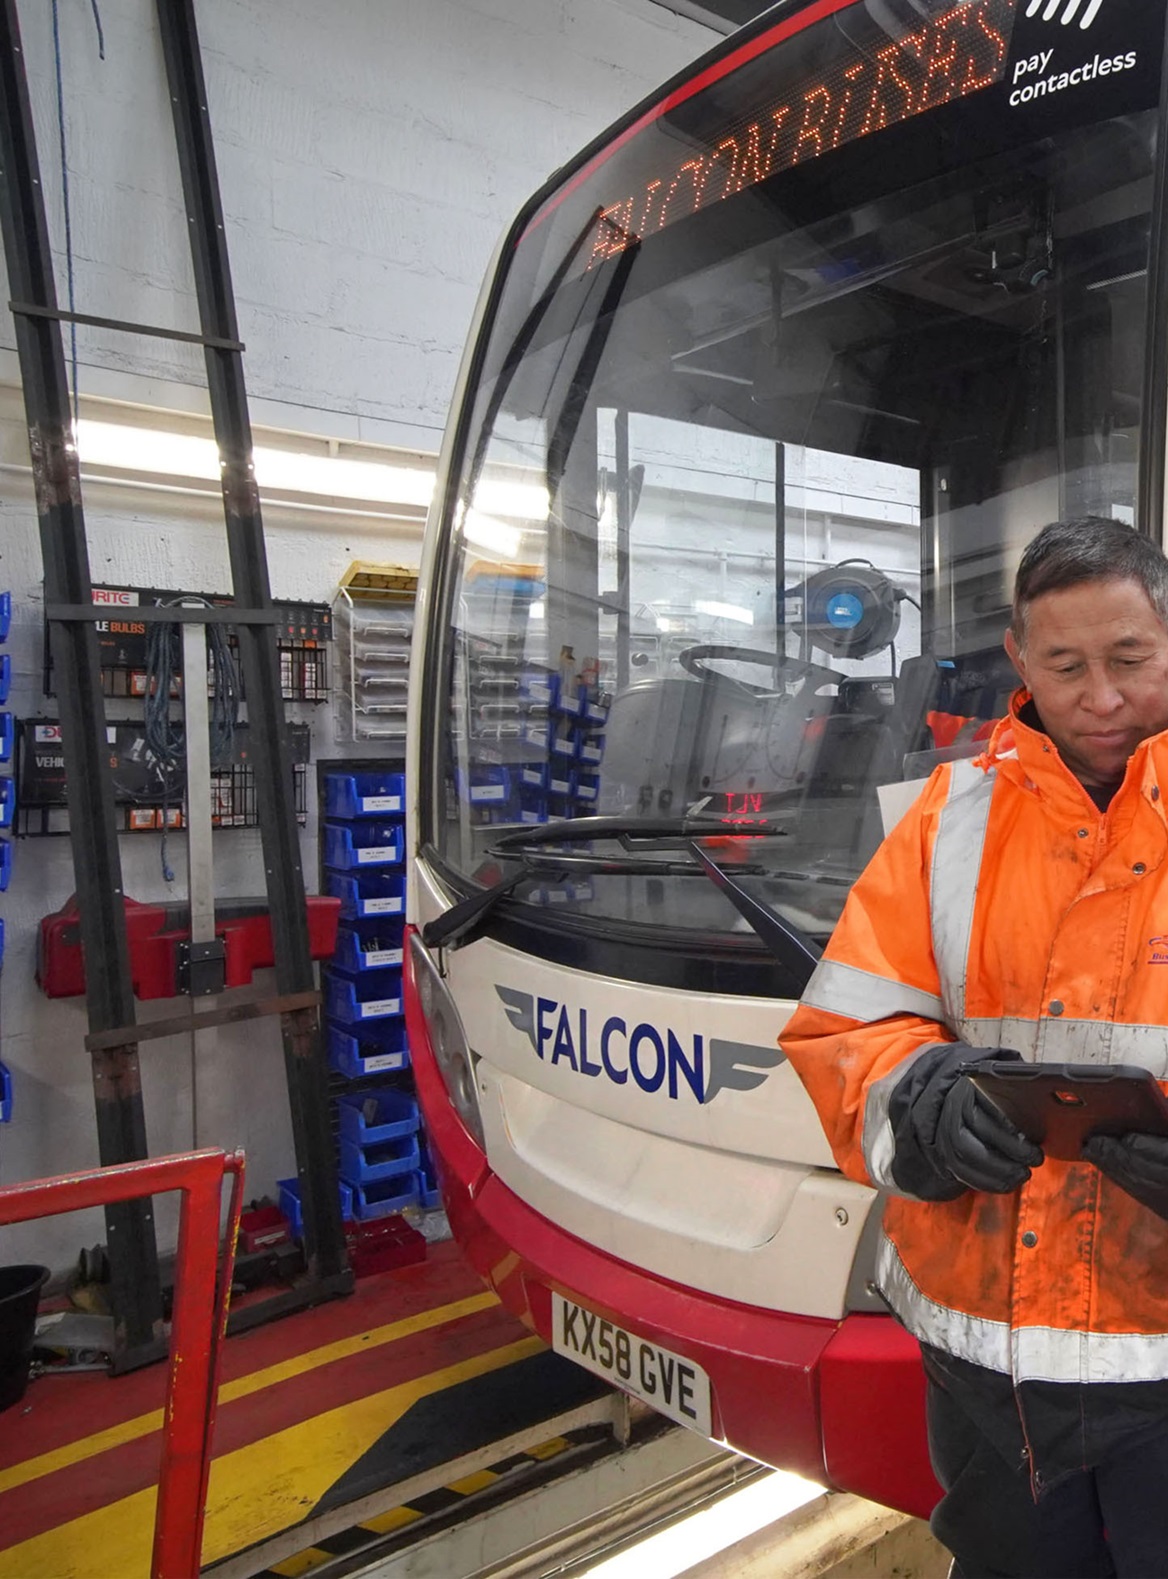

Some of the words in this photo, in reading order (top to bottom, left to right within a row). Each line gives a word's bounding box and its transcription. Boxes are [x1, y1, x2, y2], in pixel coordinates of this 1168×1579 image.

[1009, 51, 1137, 106] contactless
[1012, 48, 1054, 84] pay
[92, 591, 130, 604] RITE
[110, 622, 145, 634] BULBS
[537, 997, 704, 1105] FALCON
[563, 1300, 631, 1380] KX58
[639, 1343, 697, 1420] GVE
